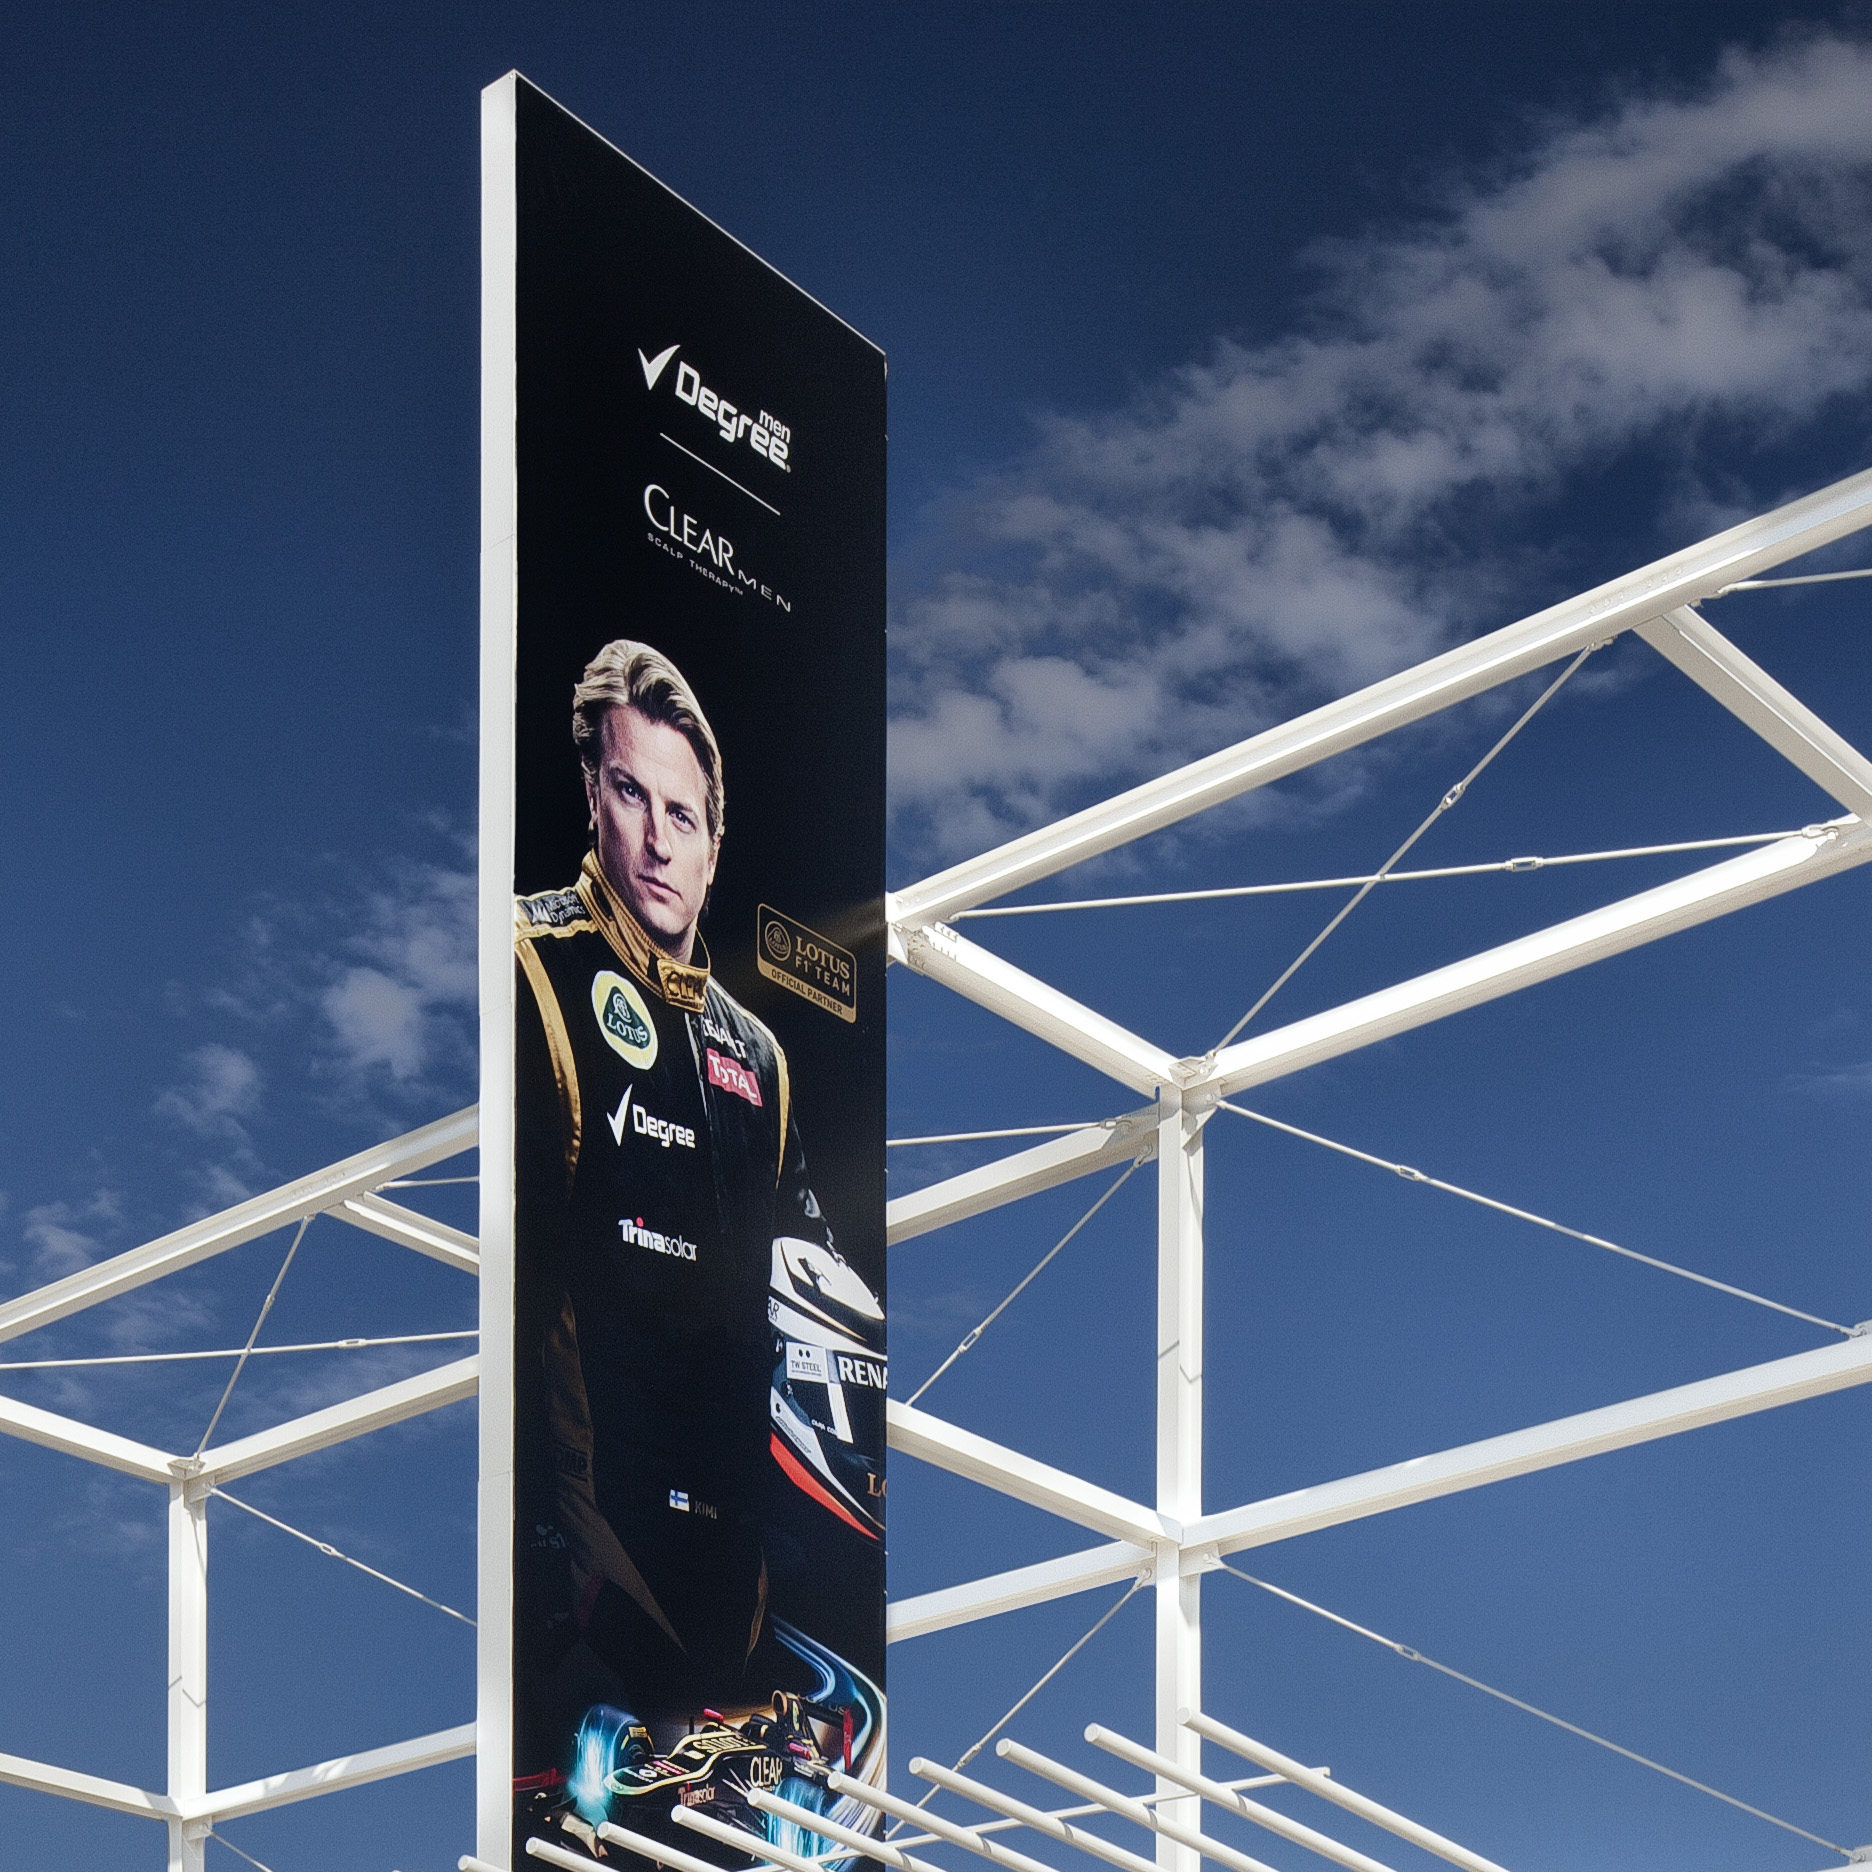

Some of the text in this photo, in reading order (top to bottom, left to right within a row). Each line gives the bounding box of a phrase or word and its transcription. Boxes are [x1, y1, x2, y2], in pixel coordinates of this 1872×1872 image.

[675, 361, 788, 471] Degree
[759, 410, 790, 443] men
[644, 484, 790, 612] CLEAR MEN
[647, 533, 683, 559] SCALP
[796, 936, 850, 979] LOTUS
[771, 969, 843, 1015] OFFICIAL PARTNER
[815, 966, 850, 996] TEAM
[606, 1013, 648, 1043] LOTUS
[632, 1104, 696, 1148] Degree
[791, 1360, 821, 1372] TW STEEL
[694, 1500, 718, 1520] KIMI
